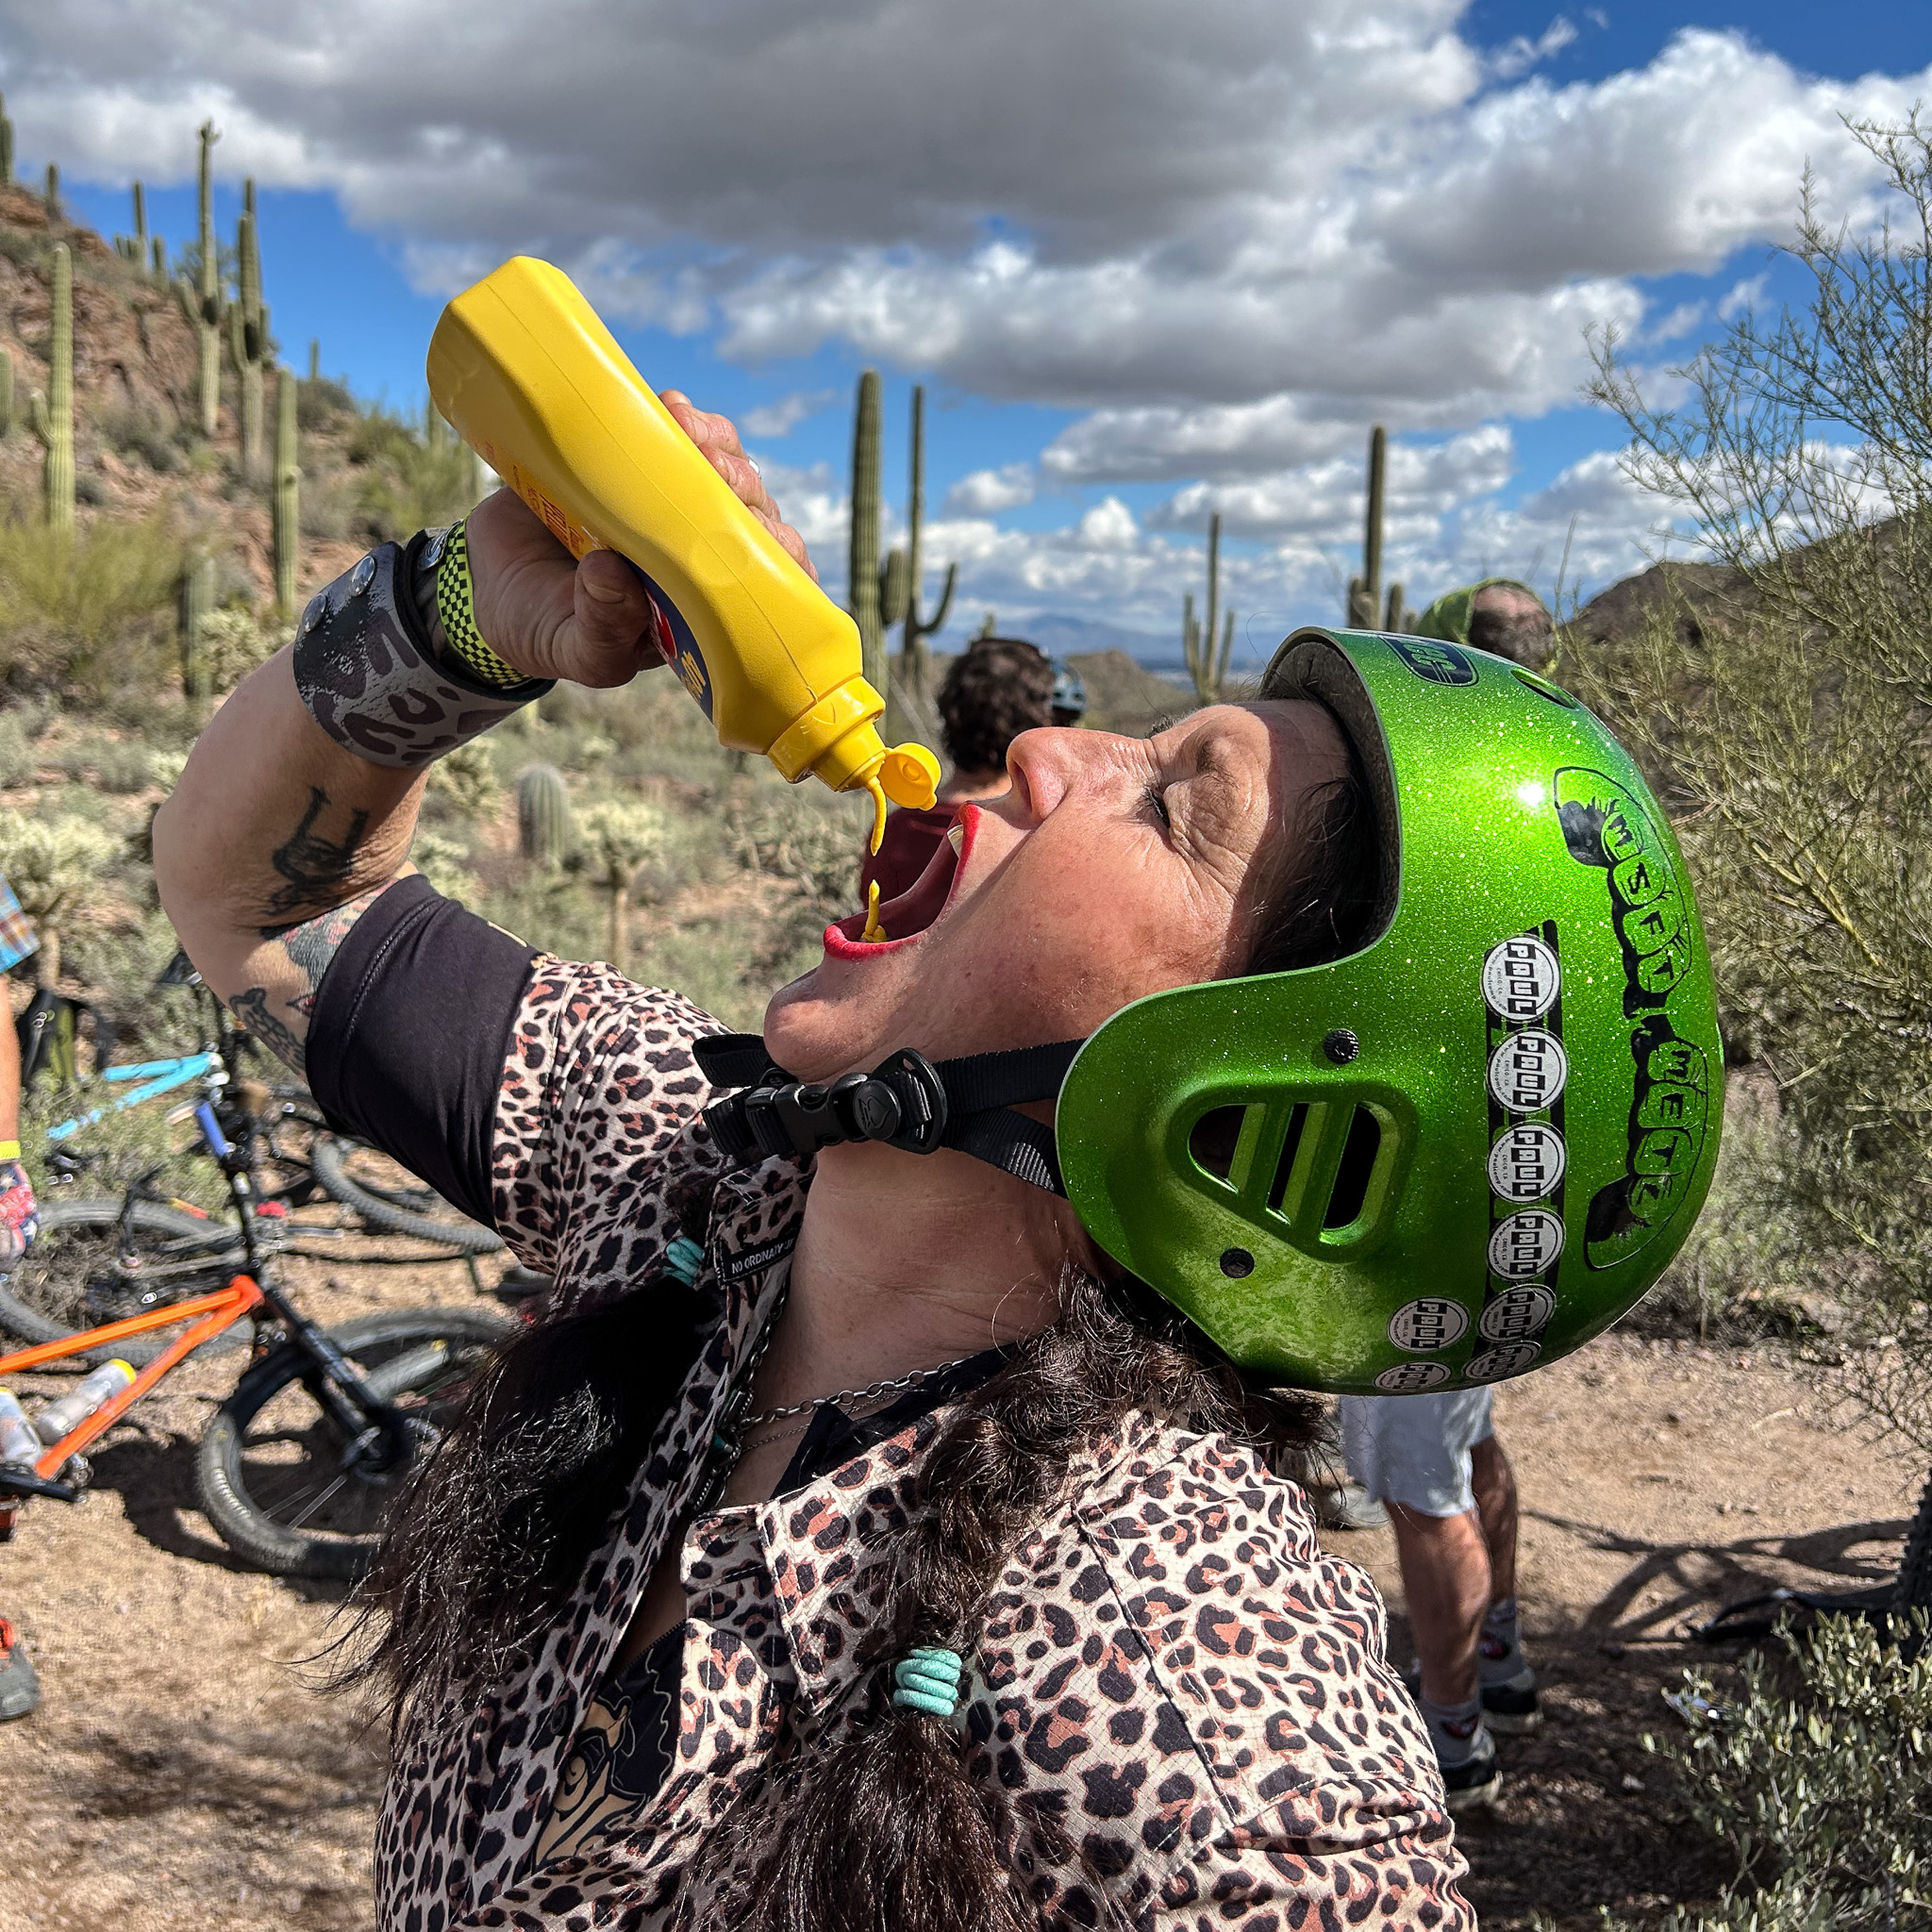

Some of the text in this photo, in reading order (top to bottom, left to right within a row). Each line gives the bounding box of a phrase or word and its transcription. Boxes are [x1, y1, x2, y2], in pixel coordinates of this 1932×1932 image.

[1507, 944, 1536, 1013] PAUL
[1516, 1037, 1542, 1105] PAUL
[1515, 1131, 1541, 1195] PAUL
[731, 1260, 743, 1274] NO
[1514, 1217, 1540, 1274] PAUL
[1415, 1302, 1443, 1347] PAUL
[1503, 1292, 1531, 1337] PAUL
